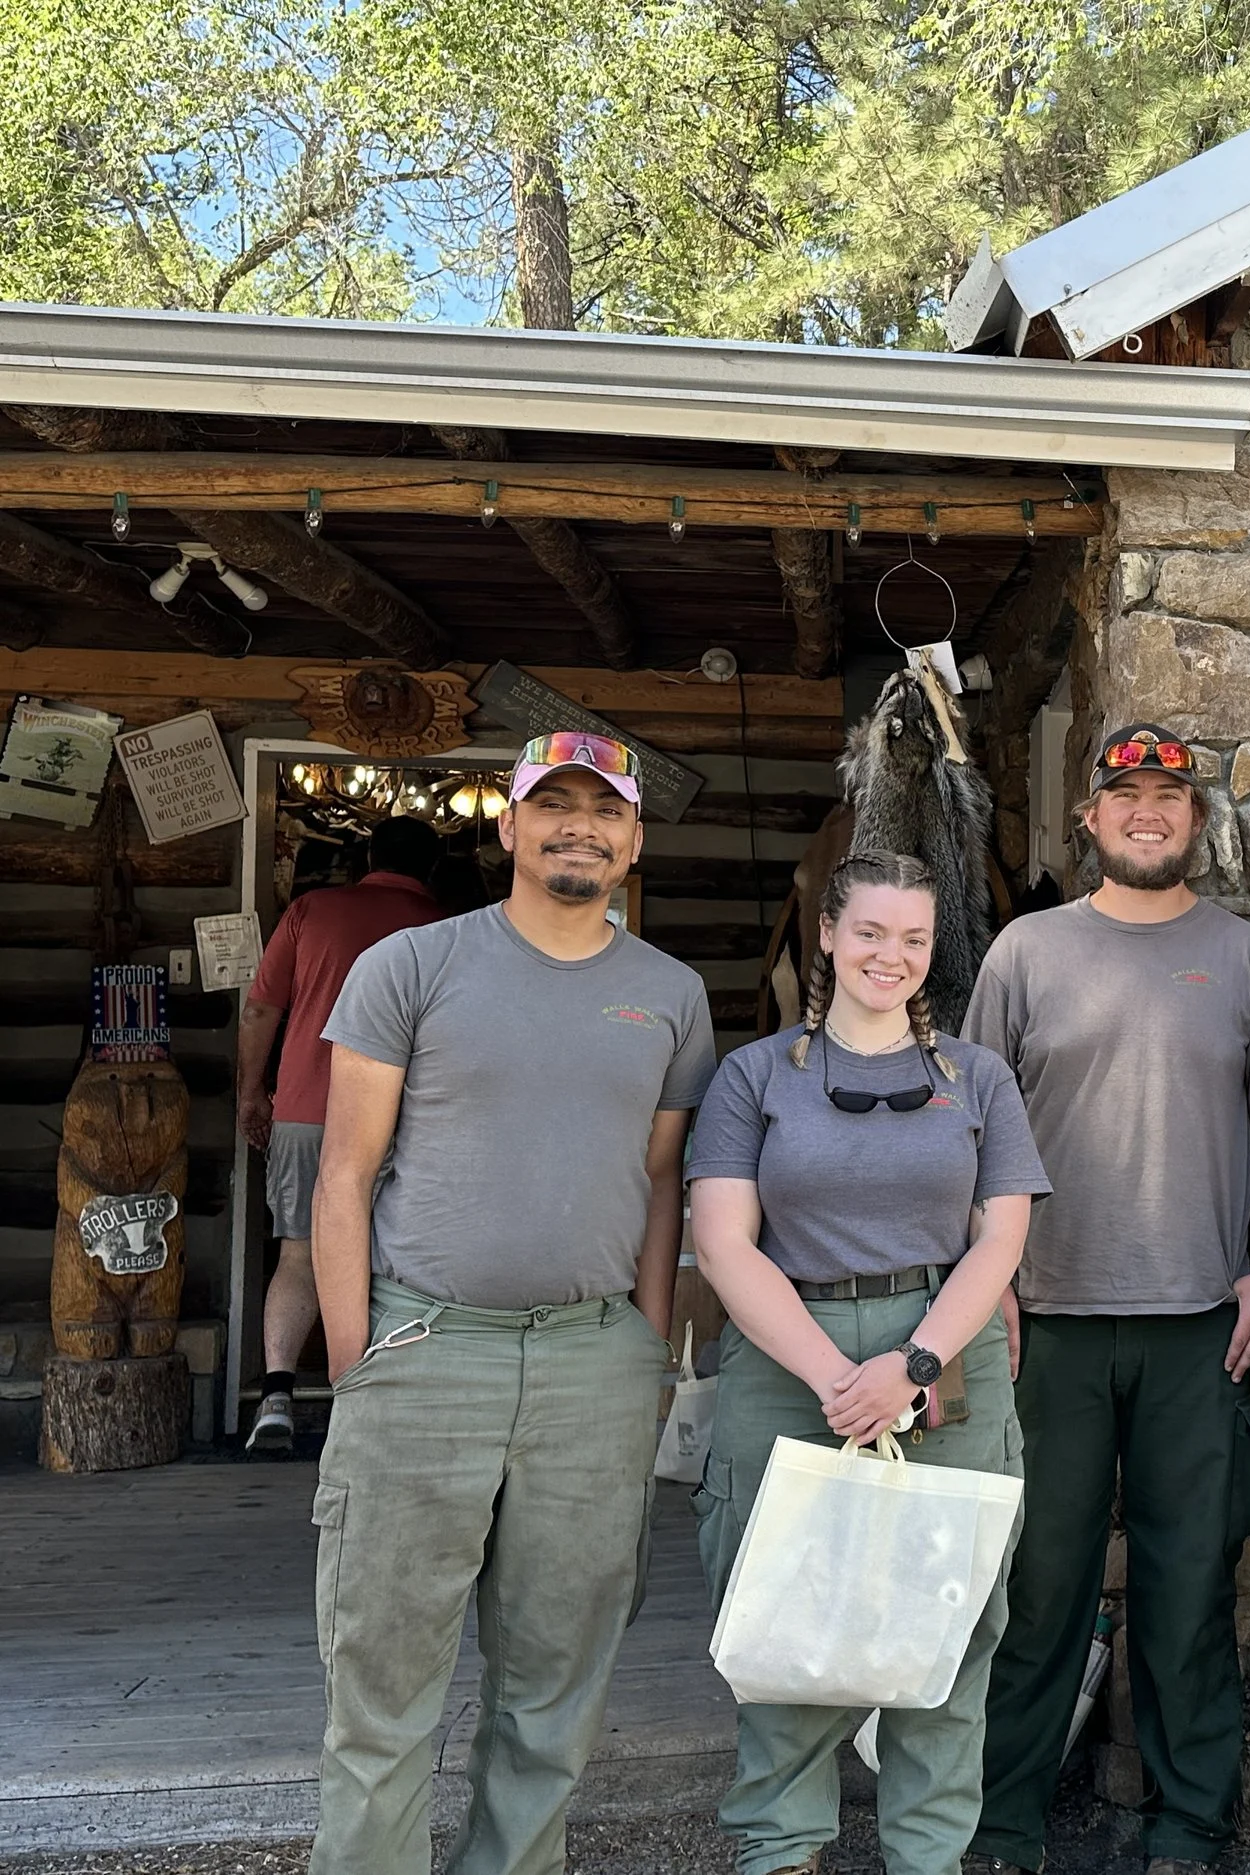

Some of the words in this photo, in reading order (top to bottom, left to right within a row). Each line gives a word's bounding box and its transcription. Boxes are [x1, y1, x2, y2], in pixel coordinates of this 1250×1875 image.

[22, 711, 107, 741] WINCHESTER
[509, 685, 557, 718] REFUSE
[641, 763, 681, 792] NYONE
[519, 675, 542, 697] WE
[543, 691, 598, 729] RESERVE
[669, 764, 685, 780] TO
[124, 736, 149, 755] NO
[130, 736, 213, 772] TRESPASSING
[145, 780, 173, 797] WILL
[173, 774, 189, 788] BE
[190, 763, 217, 783] SHOT
[148, 755, 206, 781] VIOLATORS
[155, 805, 182, 821] WILL
[182, 799, 198, 813] BE
[198, 789, 226, 808] SHOT
[156, 779, 216, 808] SURVIVORS
[180, 809, 212, 829] AGAIN
[106, 968, 153, 985] PROUD
[94, 1028, 169, 1043] AMERICANS
[81, 1199, 166, 1245] STROLLERS
[115, 1253, 160, 1269] PLEASE
